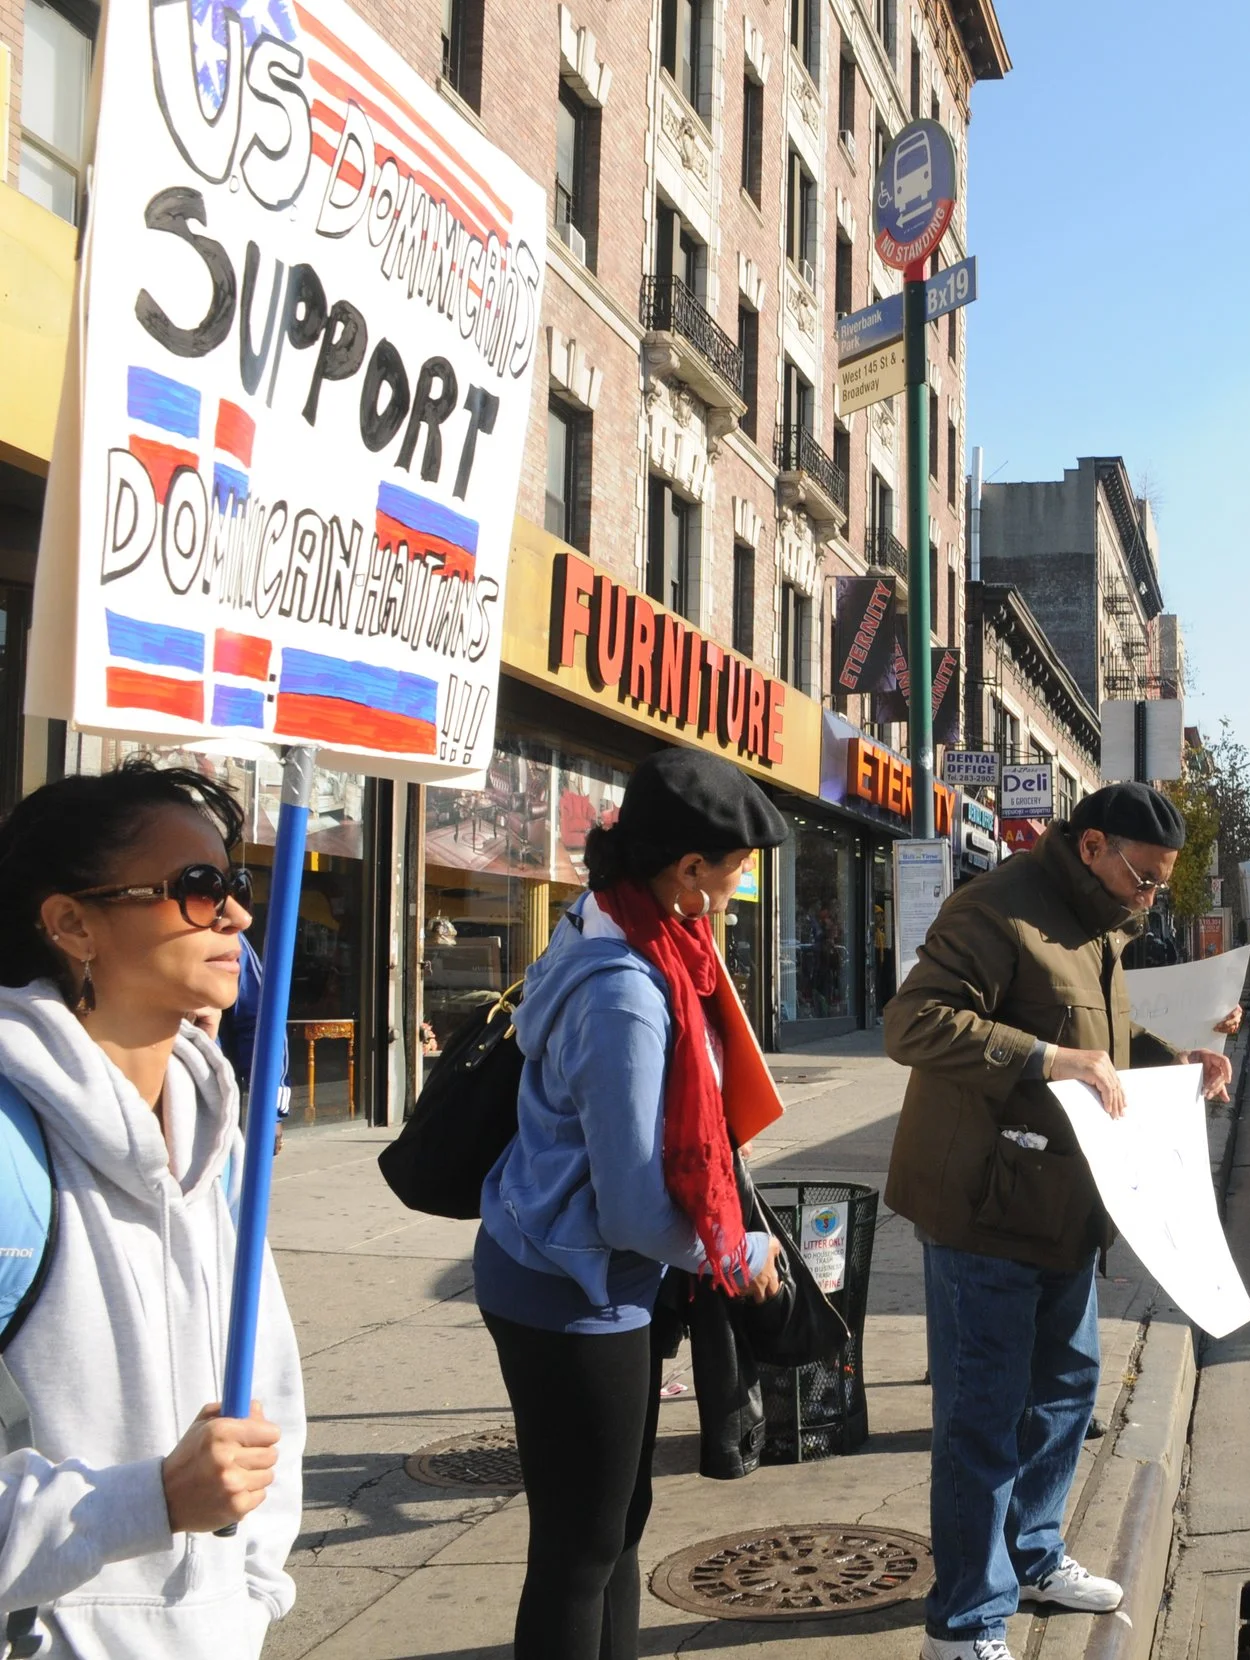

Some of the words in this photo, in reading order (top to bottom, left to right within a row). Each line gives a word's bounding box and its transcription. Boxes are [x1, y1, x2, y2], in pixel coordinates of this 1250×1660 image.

[315, 98, 540, 379] DOMINICANS
[882, 235, 895, 258] NO
[896, 206, 945, 263] STANDING
[927, 267, 969, 315] Bx19
[841, 309, 882, 337] Riverbank
[134, 185, 500, 502] SUPPORT
[841, 336, 860, 352] Park
[842, 366, 862, 386] West
[863, 360, 879, 377] 145
[880, 354, 889, 371] St
[890, 352, 897, 365] &
[842, 377, 880, 402] Broadway
[839, 579, 892, 690] ETERNITY
[561, 553, 785, 765] FURNITURE
[947, 753, 997, 764] DENTAL
[947, 764, 995, 775] OFFICE
[857, 737, 956, 836] ETERTY
[1003, 773, 1047, 793] Deli
[1015, 796, 1042, 806] GROCERY
[803, 1252, 812, 1260] NO
[804, 1239, 828, 1249] LITTER
[828, 1238, 844, 1247] ONLY
